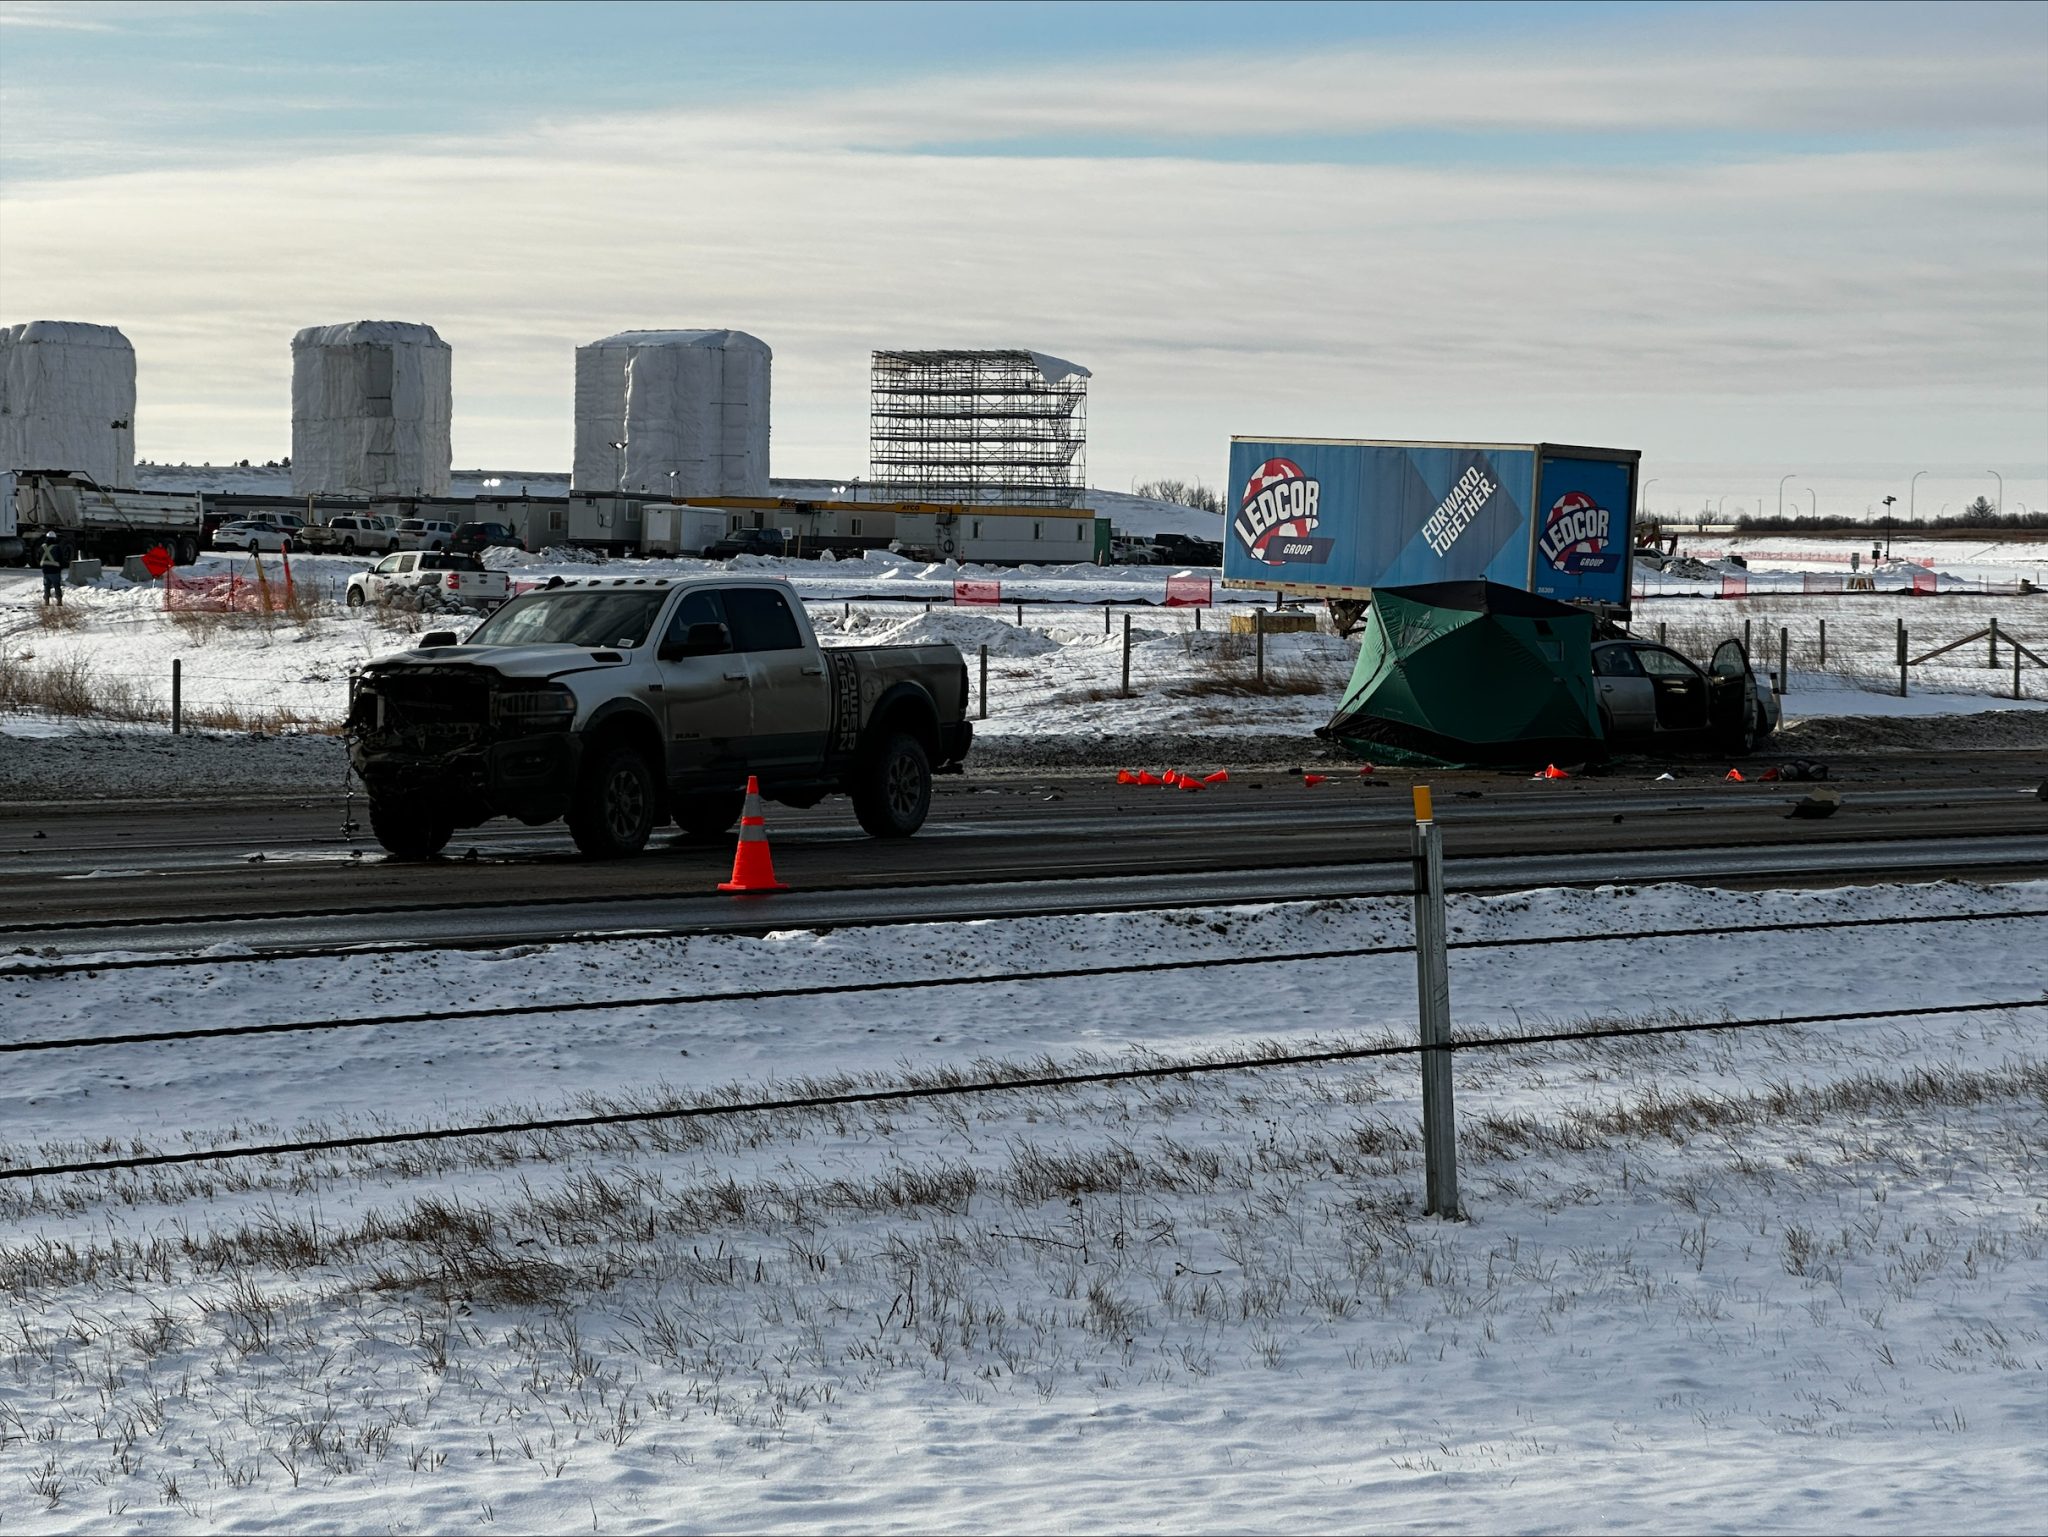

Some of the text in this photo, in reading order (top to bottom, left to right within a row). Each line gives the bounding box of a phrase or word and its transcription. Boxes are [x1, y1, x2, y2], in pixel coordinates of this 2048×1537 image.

[901, 504, 921, 512] ATCO
[1234, 480, 1319, 549] LEDCOR
[1421, 466, 1484, 544] FORWARD.
[1430, 477, 1497, 558] TOGETHER.
[1539, 509, 1609, 562] LEDCOR
[1283, 543, 1313, 555] GROUP
[1579, 558, 1604, 567] GROUP
[834, 654, 850, 751] WAGON
[841, 652, 859, 751] POWER
